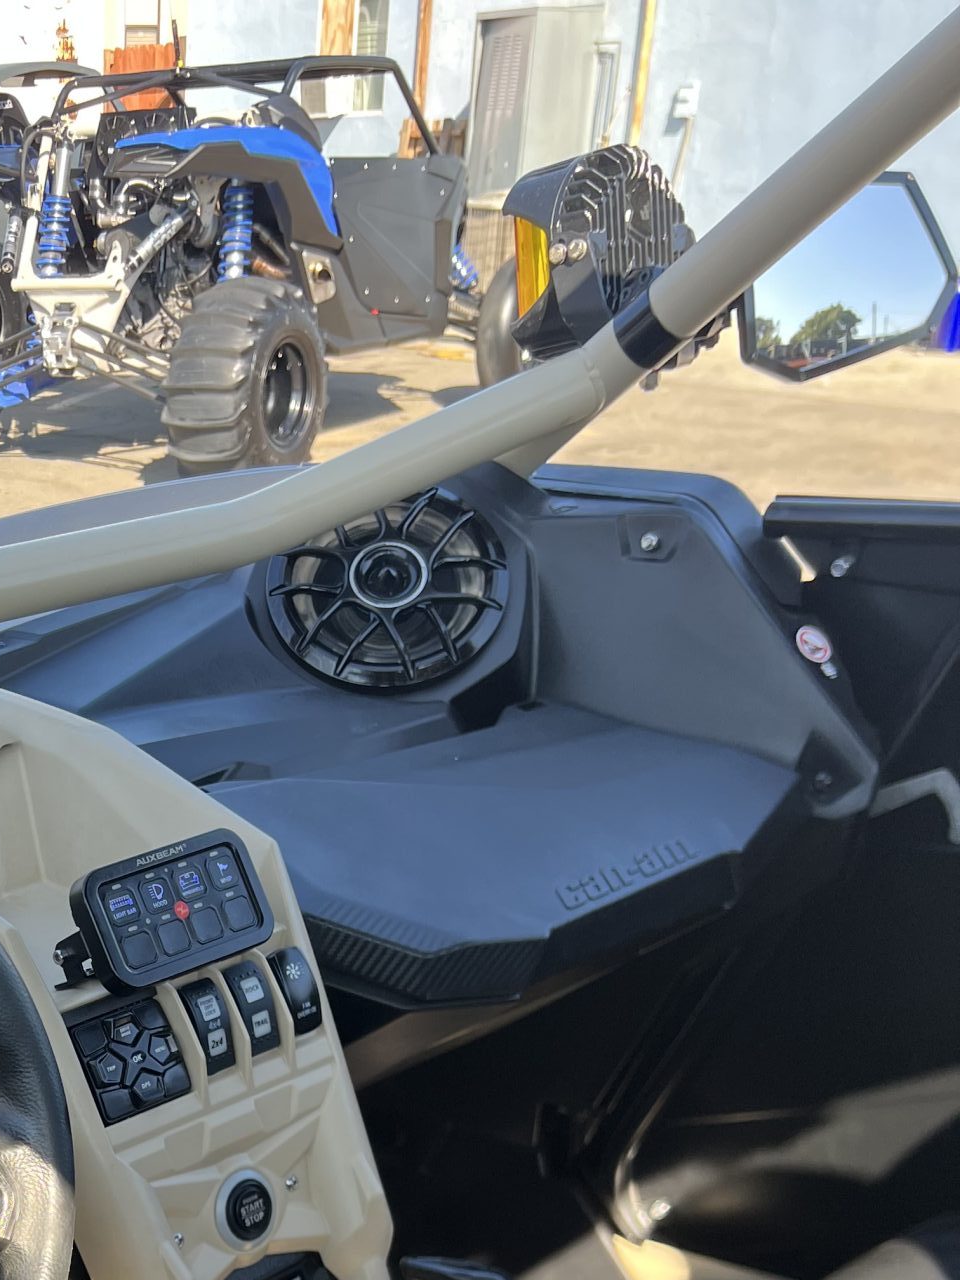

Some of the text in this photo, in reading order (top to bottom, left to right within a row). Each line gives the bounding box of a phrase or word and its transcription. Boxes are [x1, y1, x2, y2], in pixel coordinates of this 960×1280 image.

[136, 846, 184, 867] AUXBEAM
[555, 840, 697, 911] can-am
[152, 899, 168, 909] HOOD
[211, 1037, 223, 1049] 2x4
[132, 1053, 143, 1063] OK
[241, 1198, 263, 1215] START
[245, 1211, 264, 1227] STOP
